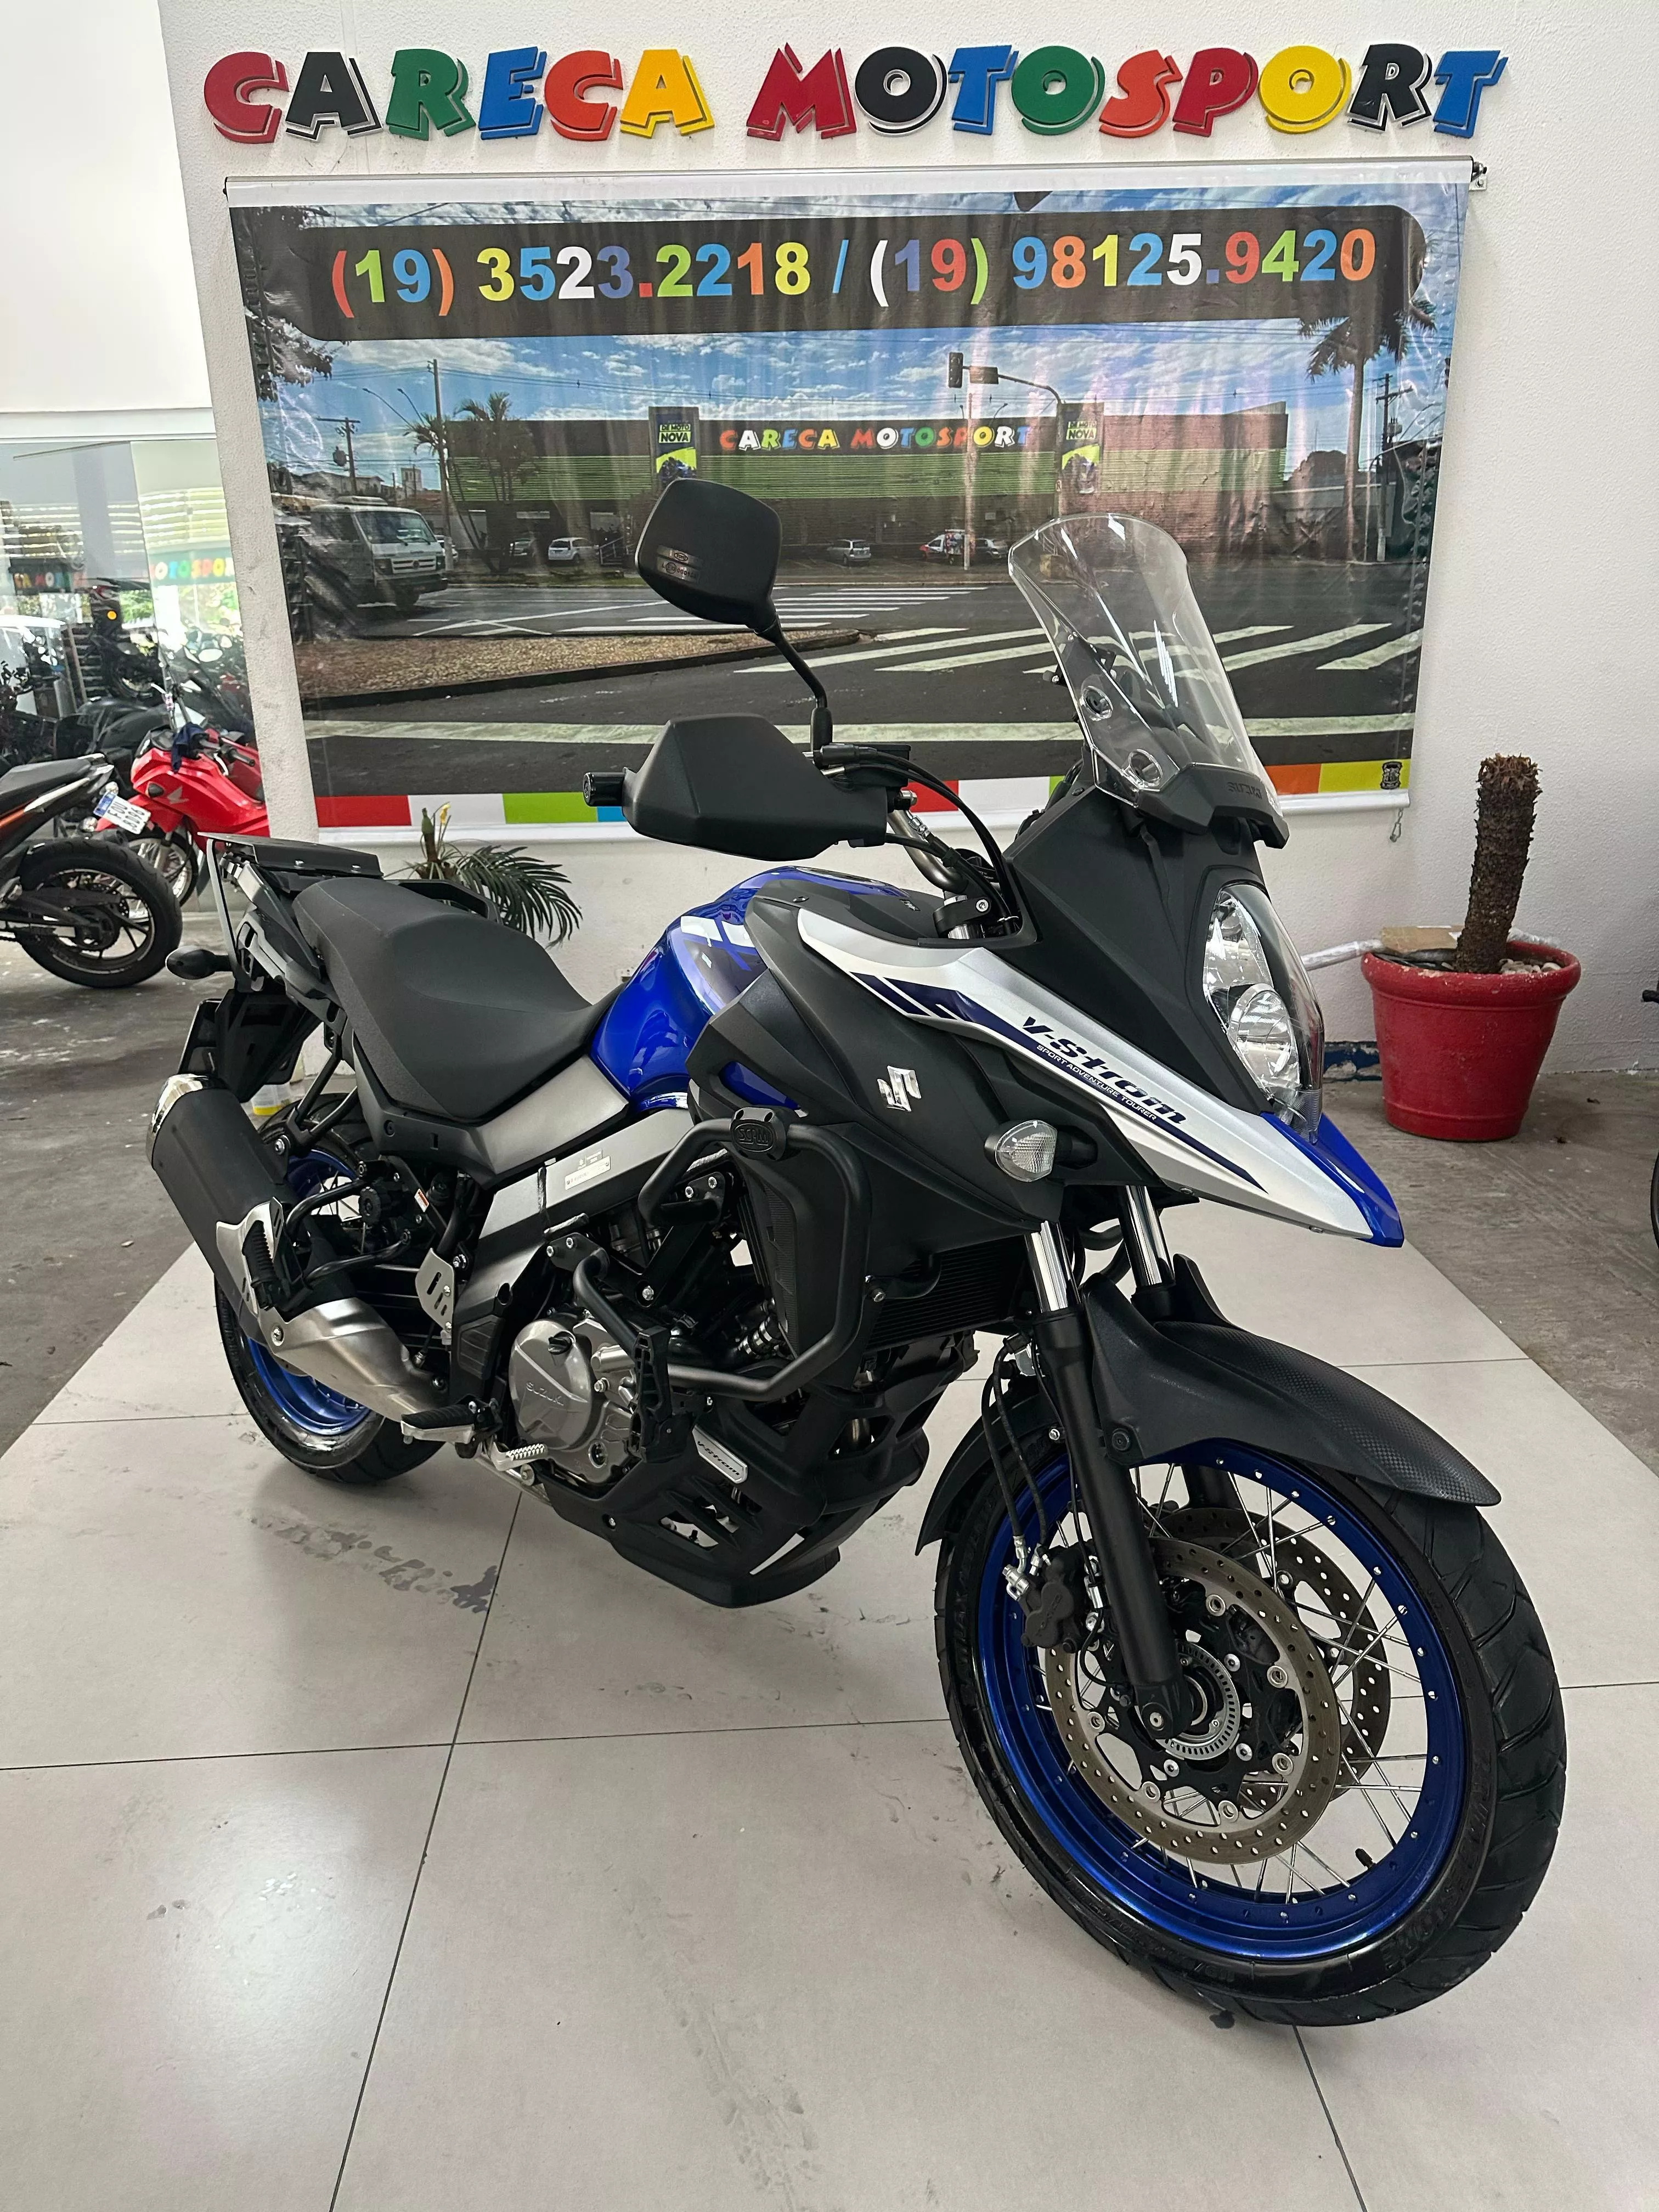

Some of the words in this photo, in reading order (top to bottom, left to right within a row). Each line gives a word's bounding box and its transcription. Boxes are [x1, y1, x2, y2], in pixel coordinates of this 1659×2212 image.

[204, 46, 715, 143] CARECA
[746, 42, 1508, 141] MOTOSPORT
[332, 247, 454, 318] (19)
[476, 241, 811, 302] 3523.2218
[870, 238, 989, 308] (19)
[1012, 228, 1376, 290] 98125.9420
[661, 432, 689, 442] NOVA
[719, 428, 840, 451] CARECA
[850, 426, 1031, 449] MOTOSPORT
[1068, 429, 1094, 439] NOVA
[1022, 1016, 1187, 1124] V-Strom
[1036, 1045, 1068, 1065] SPORT
[1066, 1063, 1120, 1098] ADVENTURE
[1122, 1096, 1158, 1121] TOURER
